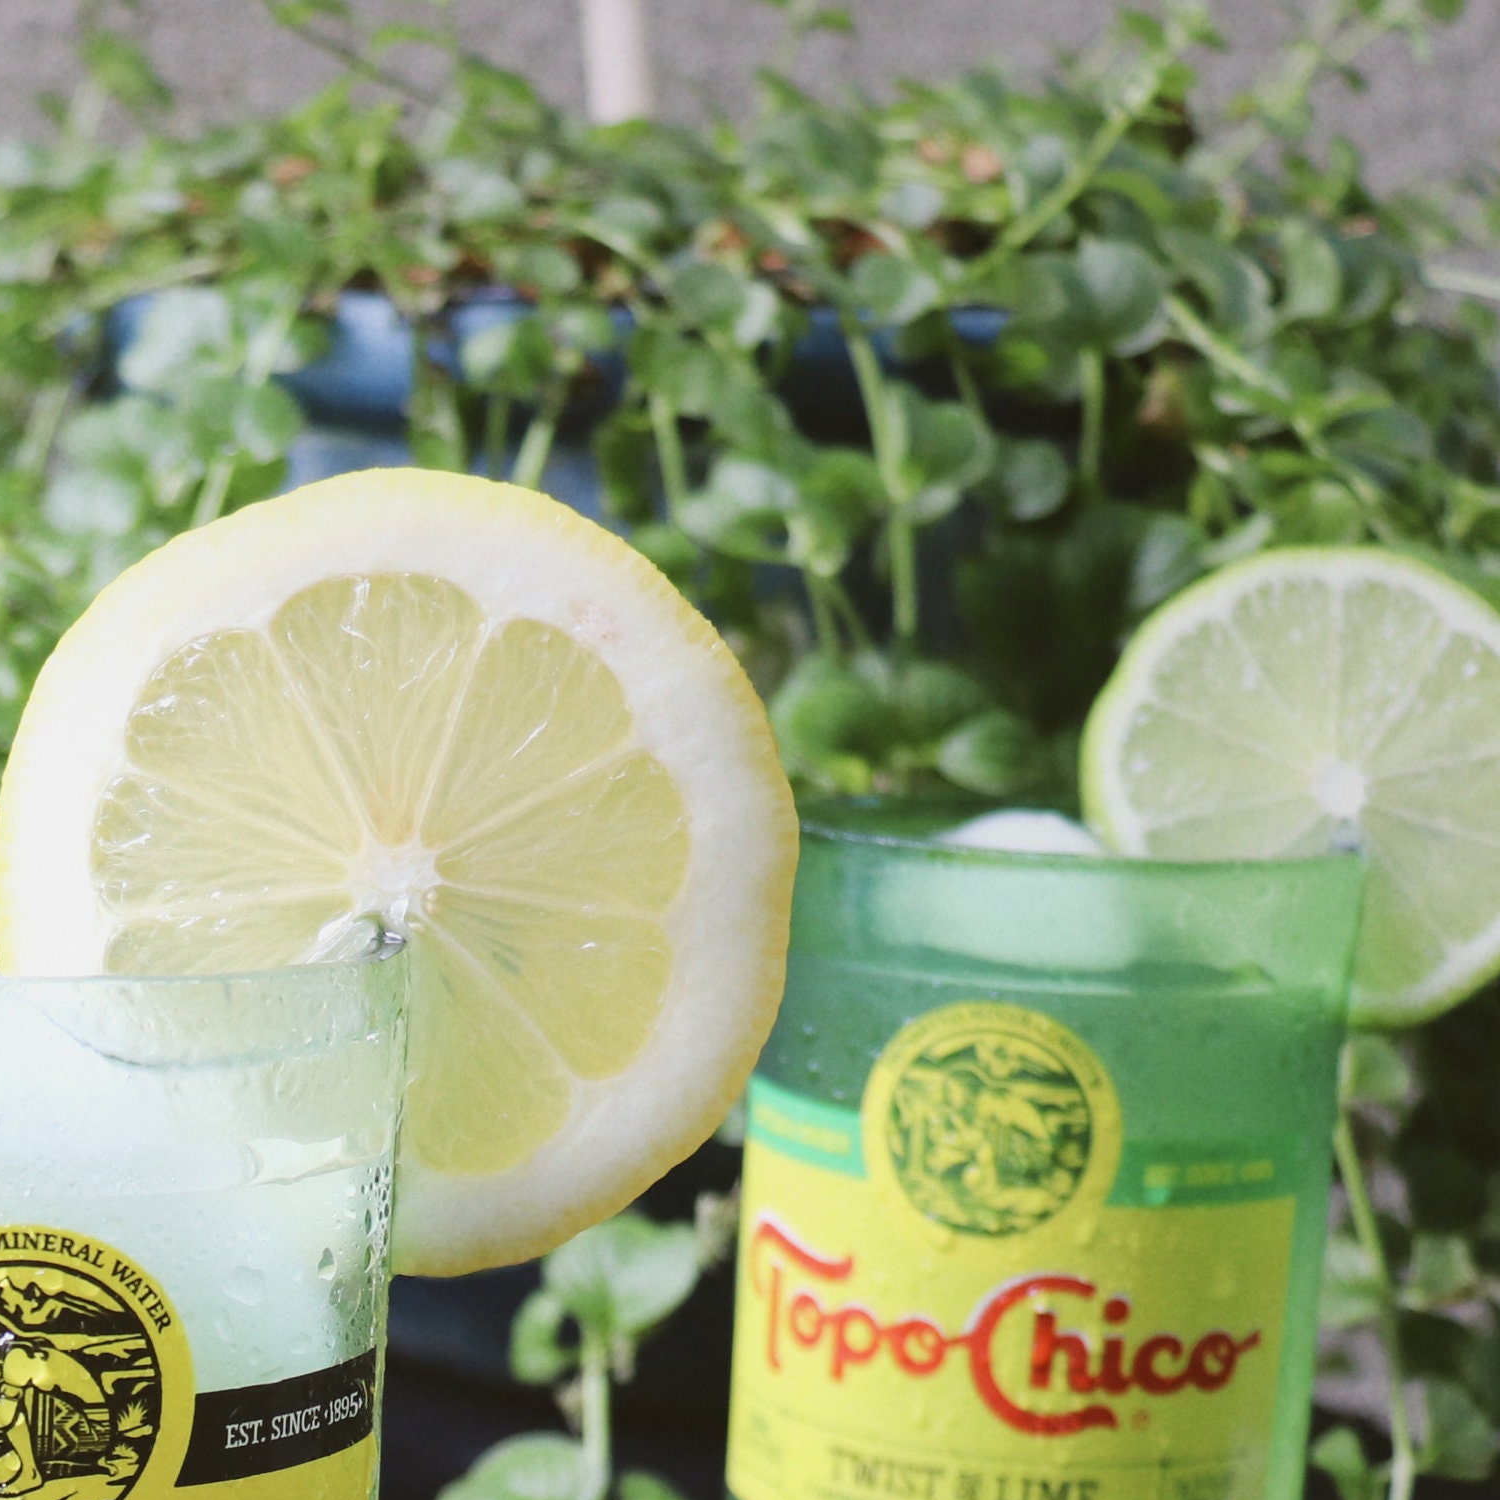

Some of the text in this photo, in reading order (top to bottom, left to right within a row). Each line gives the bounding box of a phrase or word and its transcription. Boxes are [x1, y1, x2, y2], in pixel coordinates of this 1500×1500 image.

[111, 1259, 172, 1334] WATER
[752, 1210, 1261, 1436] Topo Chico
[225, 1419, 266, 1449] EST.
[271, 1405, 321, 1441] SINCE
